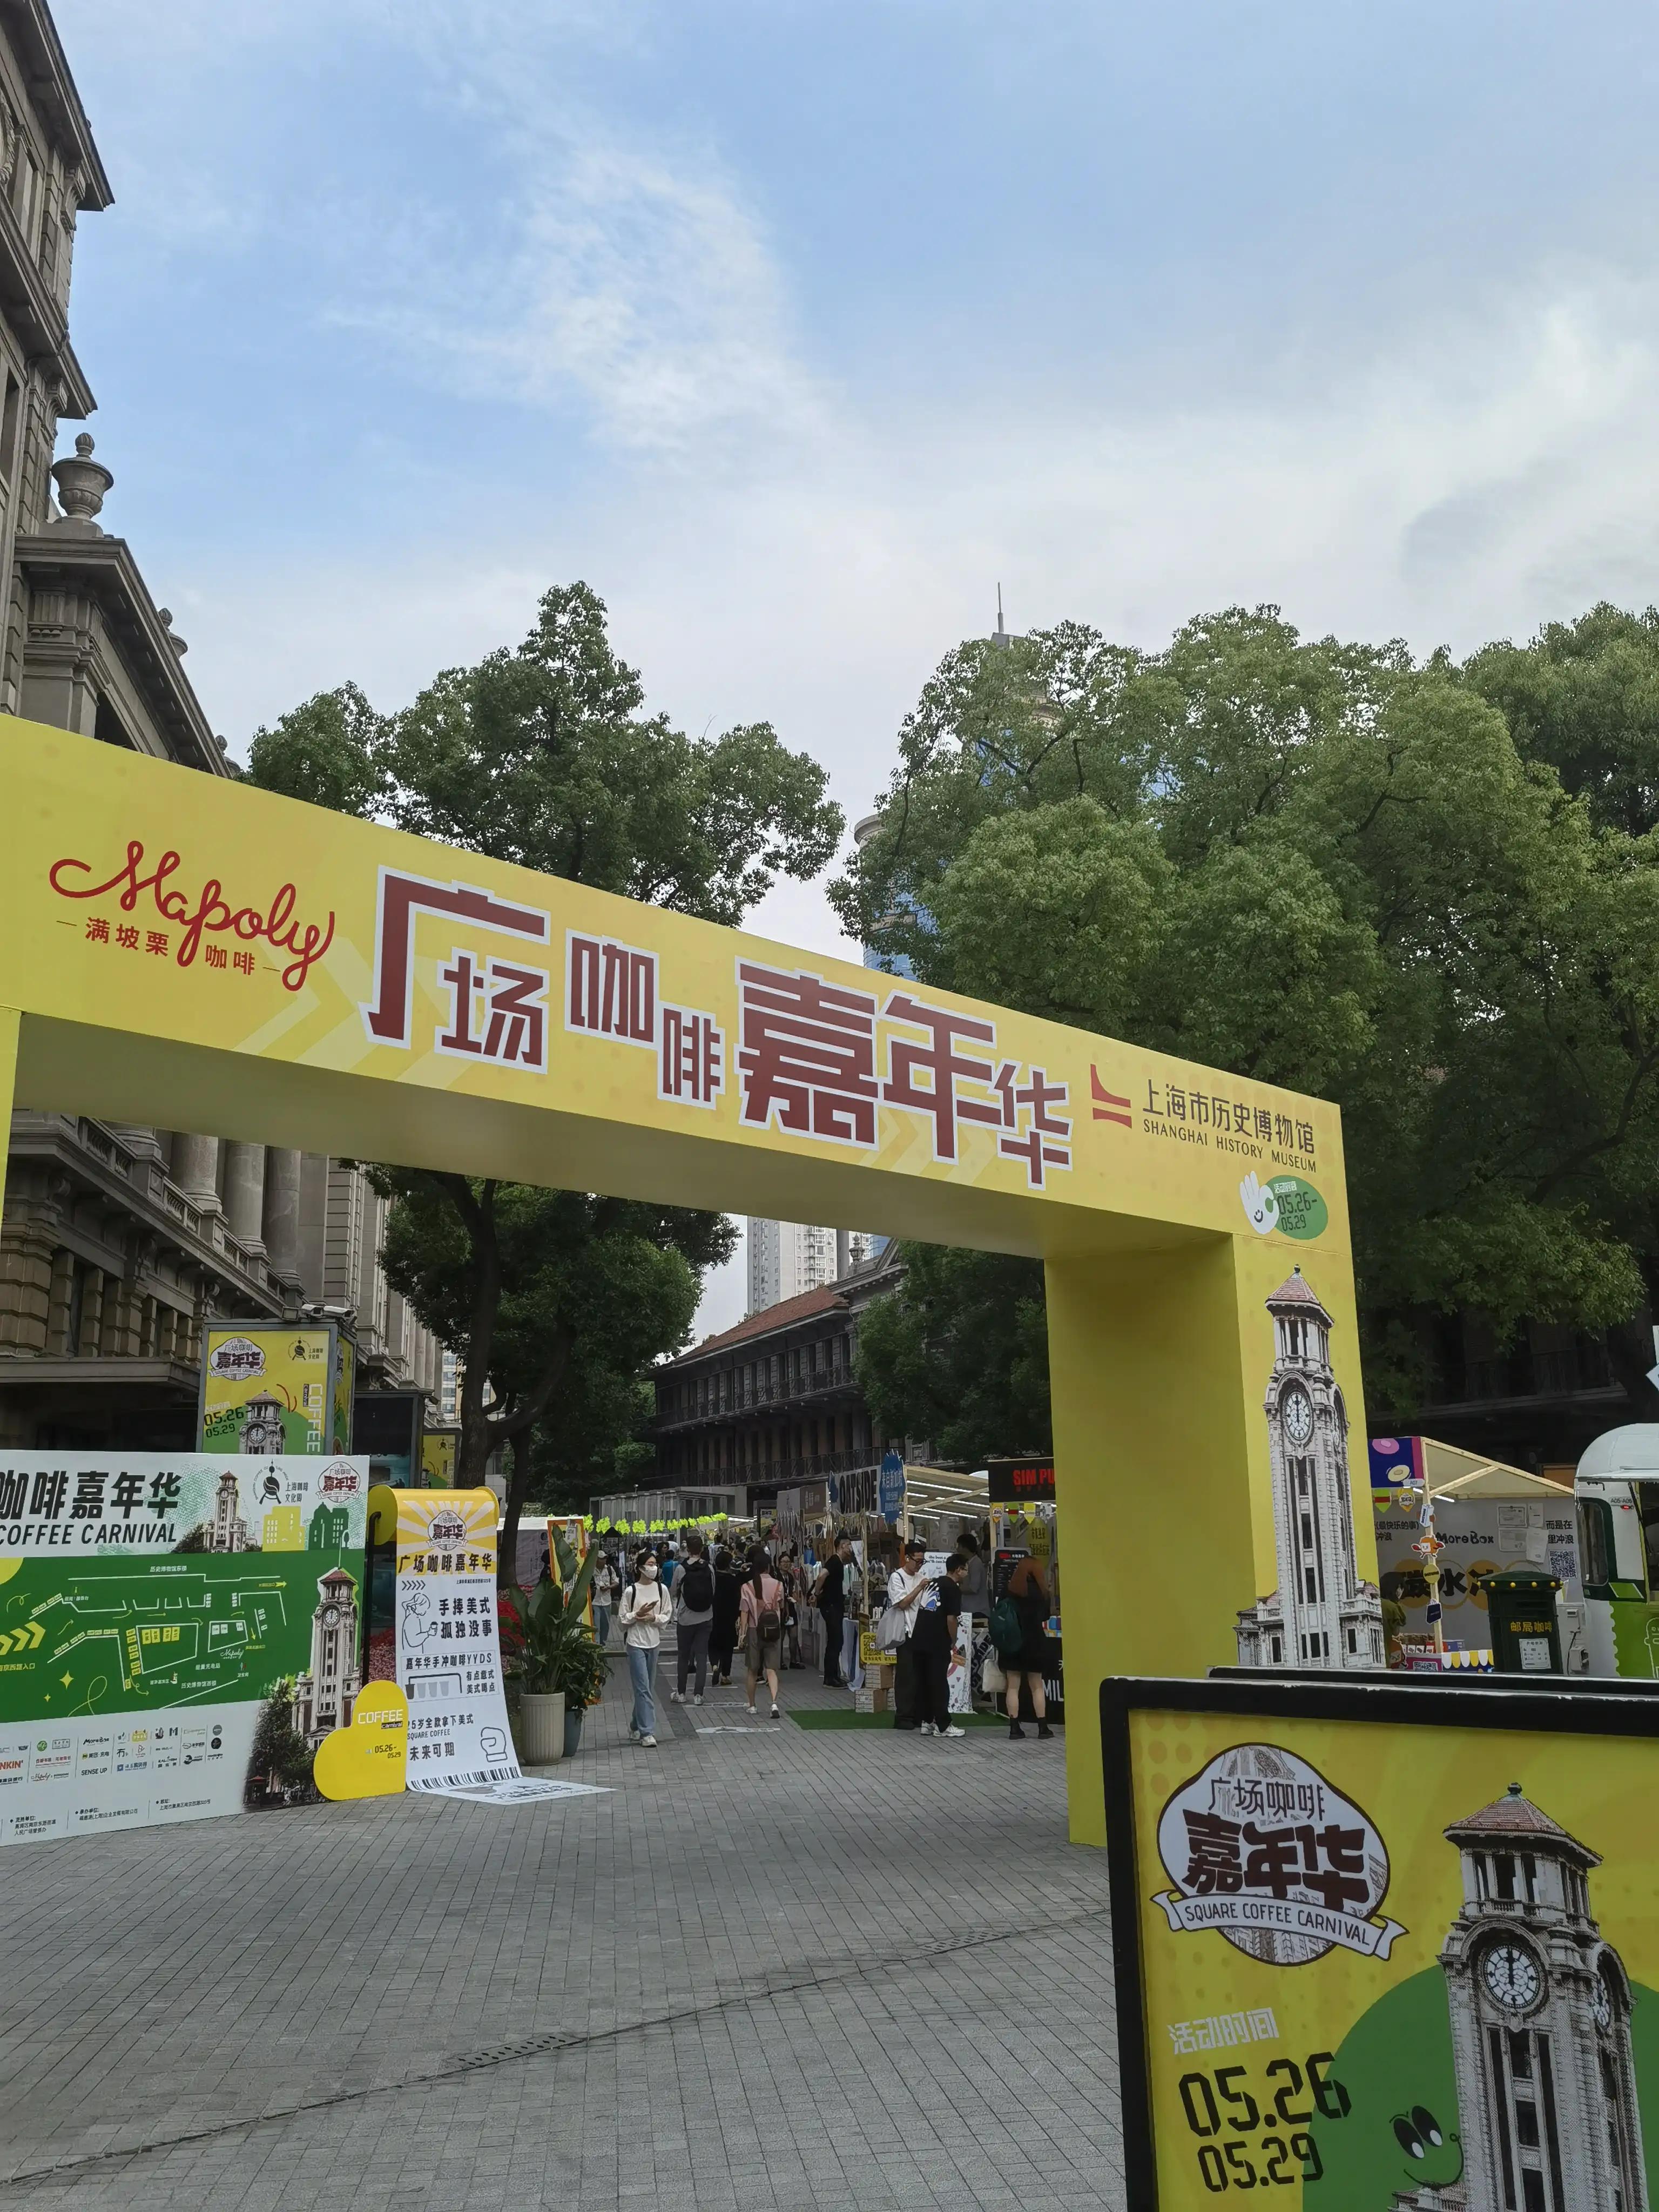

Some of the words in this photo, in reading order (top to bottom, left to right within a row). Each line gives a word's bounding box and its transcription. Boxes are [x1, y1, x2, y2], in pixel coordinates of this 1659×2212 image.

[49, 840, 335, 992] Mapoly
[85, 916, 170, 957] 满坡栗
[205, 945, 255, 976] 咖啡
[365, 871, 1073, 1186] 广场咖啡嘉年华
[1143, 1079, 1314, 1154] 上海市历史博物馆
[1143, 1119, 1208, 1146] SHANGHAI
[1216, 1136, 1263, 1159] HISTORY
[1272, 1150, 1316, 1172] MUSEUM
[1277, 1191, 1317, 1215] 05.26-
[1281, 1214, 1306, 1231] 05.29
[215, 1352, 261, 1370] 嘉年华
[307, 1384, 323, 1452] COFFEE
[206, 1423, 235, 1438] 05.29
[285, 1481, 308, 1492] 上海咖啡
[322, 1475, 358, 1492] 嘉年华
[1013, 1469, 1037, 1485] SIM
[0, 1469, 183, 1520] 咖啡嘉年华
[839, 1468, 877, 1514] OATSIDE
[81, 1523, 177, 1545] CARNIVAL
[432, 1524, 463, 1539] 嘉年华
[1546, 1520, 1573, 1529] 而是在
[398, 1553, 492, 1573] 广场咖啡嘉年华
[439, 1597, 490, 1616] 手捧美式
[441, 1619, 492, 1639] 孤独没事
[1510, 1621, 1553, 1632] 邮局咖啡
[406, 1653, 492, 1670] 嘉年华手冲咖啡YYDS
[358, 1709, 403, 1724] COFFEE
[407, 1730, 428, 1741] SQUARE
[430, 1729, 450, 1737] COFFEE
[409, 1742, 455, 1762] 未来可期
[1208, 1776, 1325, 1821] 广场咖啡
[1182, 1809, 1370, 1912] 嘉年华
[1185, 1903, 1238, 1922] SQUARE
[1243, 1903, 1292, 1924] COFFEE
[1297, 1910, 1370, 1945] CARNIVAL
[1166, 2007, 1280, 2054] 活动时间
[1178, 2052, 1352, 2137] 05.26
[1197, 2132, 1324, 2193] 05.29
